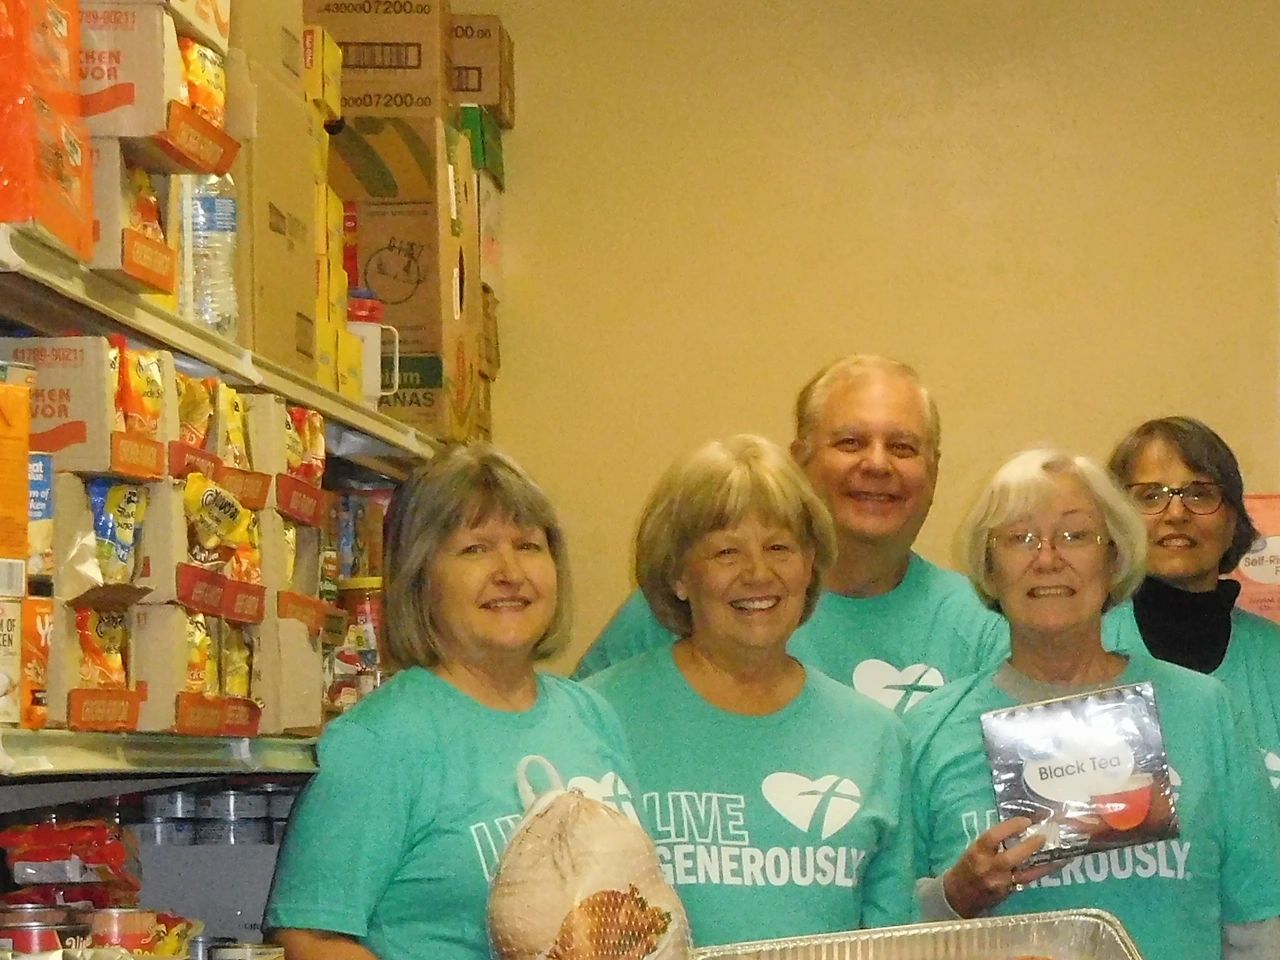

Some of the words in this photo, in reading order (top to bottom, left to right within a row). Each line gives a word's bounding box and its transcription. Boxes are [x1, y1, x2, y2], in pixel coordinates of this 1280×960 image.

[1039, 759, 1086, 781] Black
[1091, 755, 1121, 771] Tea
[643, 790, 750, 847] LIVE
